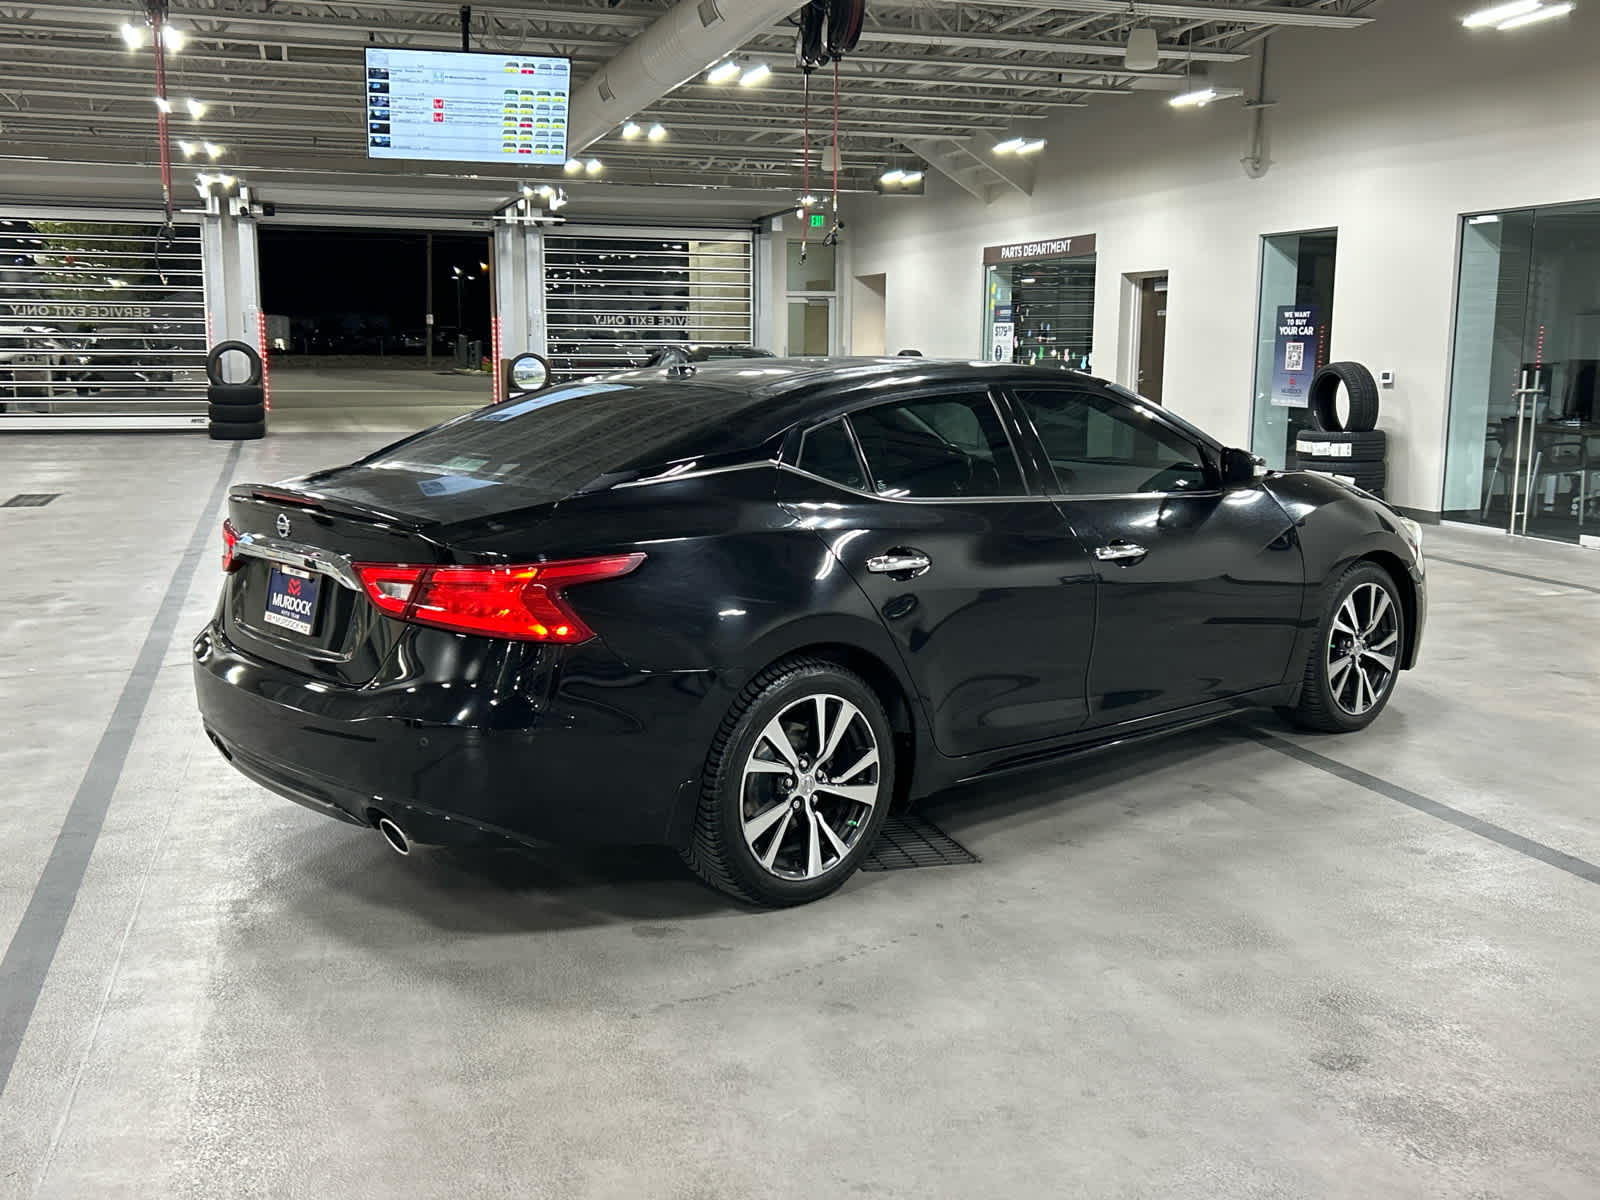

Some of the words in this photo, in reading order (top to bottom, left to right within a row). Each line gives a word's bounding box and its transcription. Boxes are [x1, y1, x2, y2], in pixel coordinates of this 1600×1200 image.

[1001, 246, 1022, 259] PARTS
[1023, 240, 1072, 257] DEPARTMENT
[1295, 318, 1307, 326] BUY
[1280, 327, 1298, 336] YOUR
[1298, 326, 1314, 336] CAR
[272, 592, 312, 616] MURDOCK
